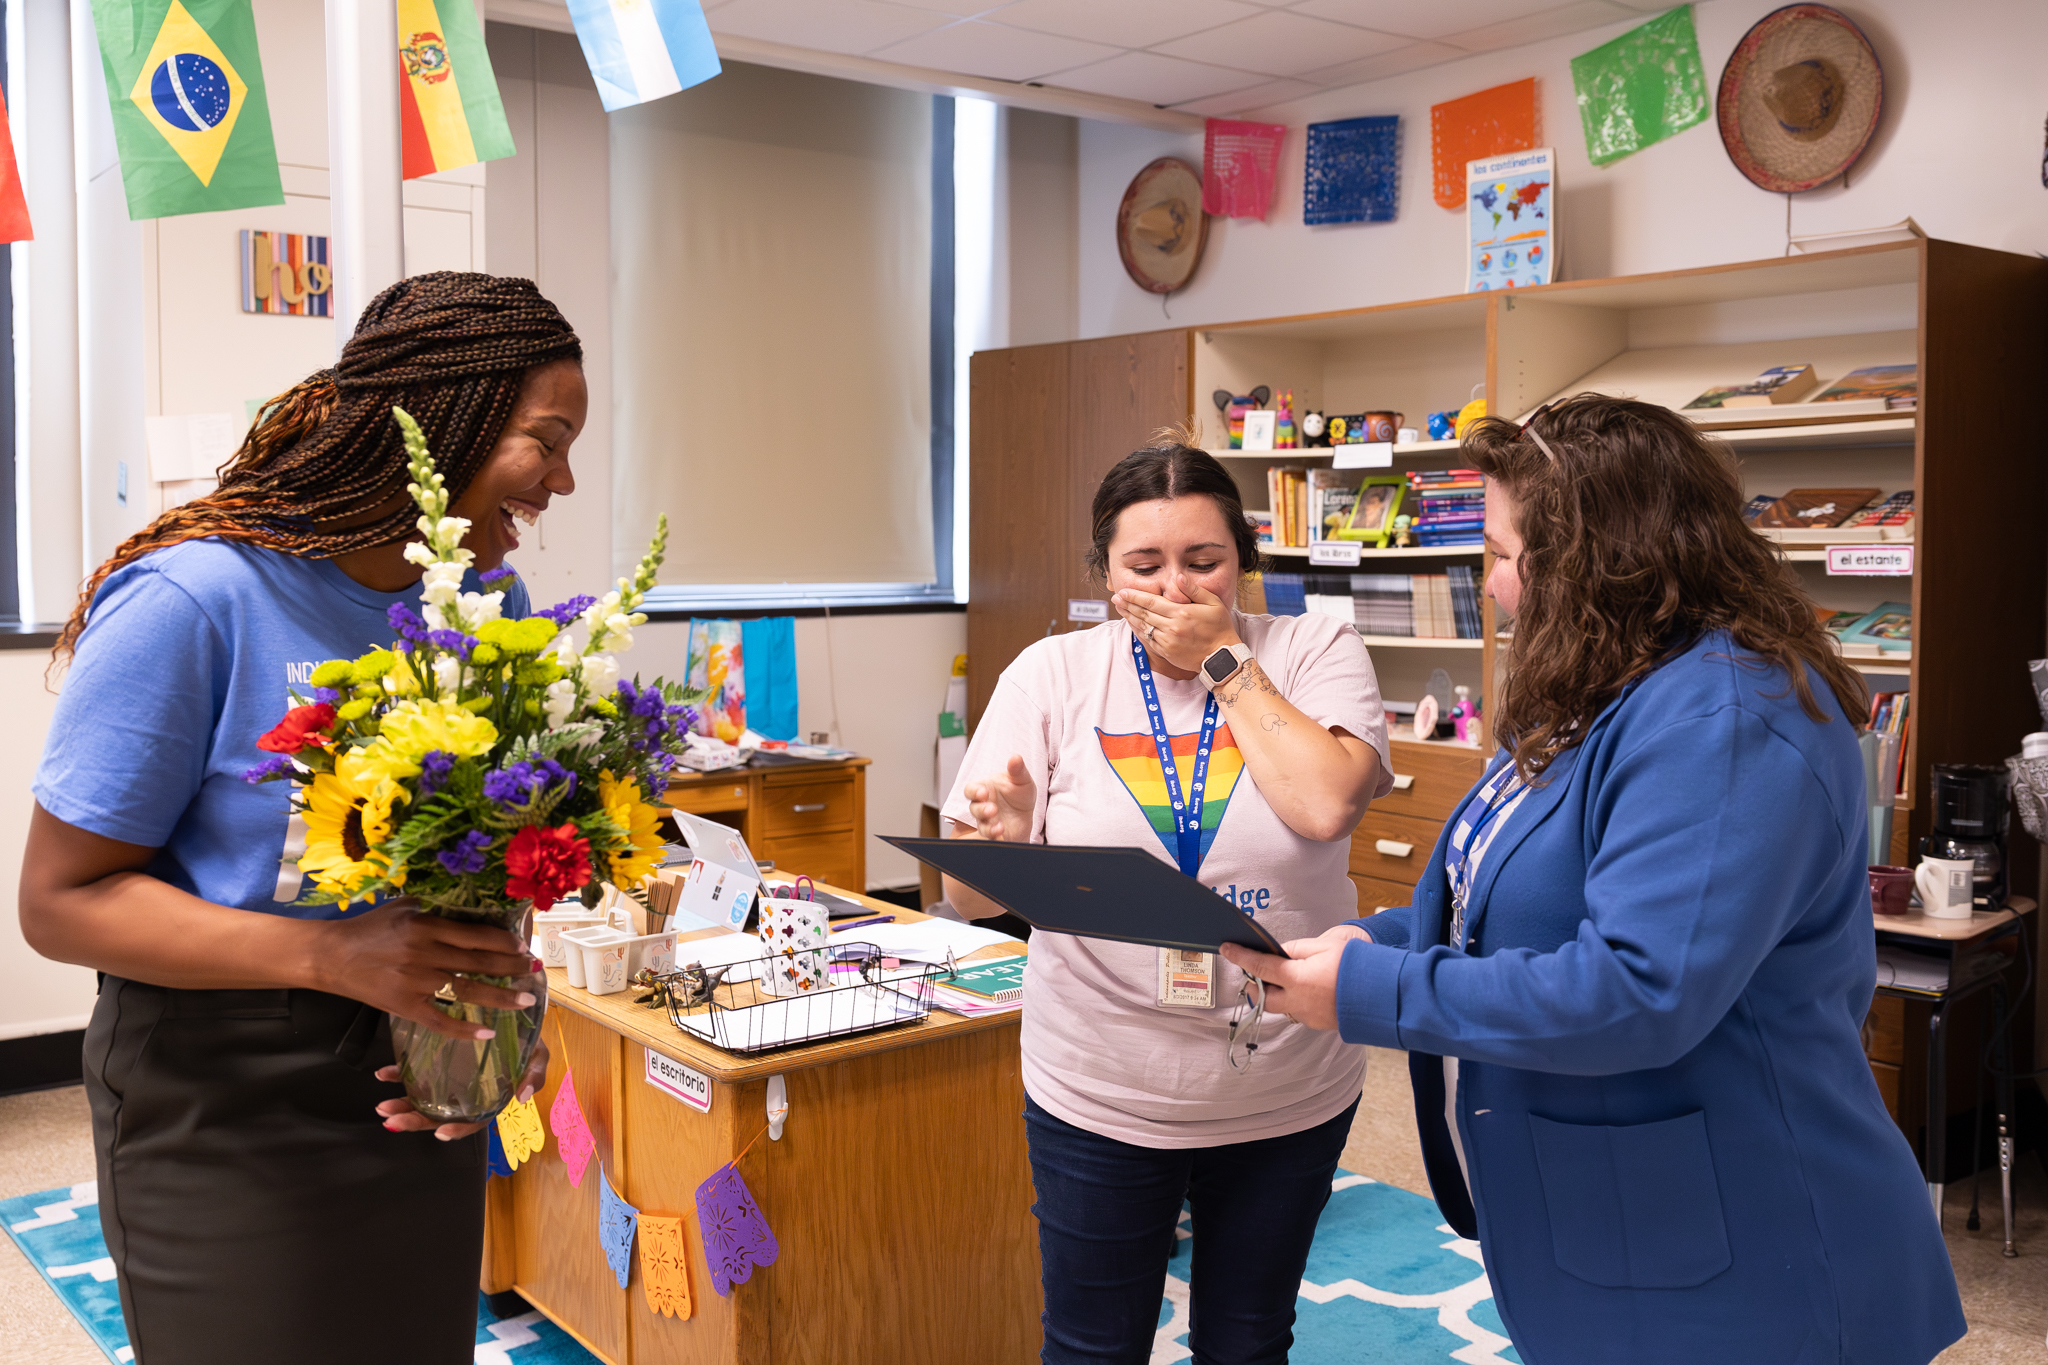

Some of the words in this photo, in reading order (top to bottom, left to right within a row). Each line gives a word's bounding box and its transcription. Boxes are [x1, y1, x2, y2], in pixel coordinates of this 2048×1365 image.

[1840, 553, 1852, 565] el
[1856, 554, 1902, 565] estante
[651, 1055, 659, 1071] el
[660, 1062, 705, 1093] escritorio
